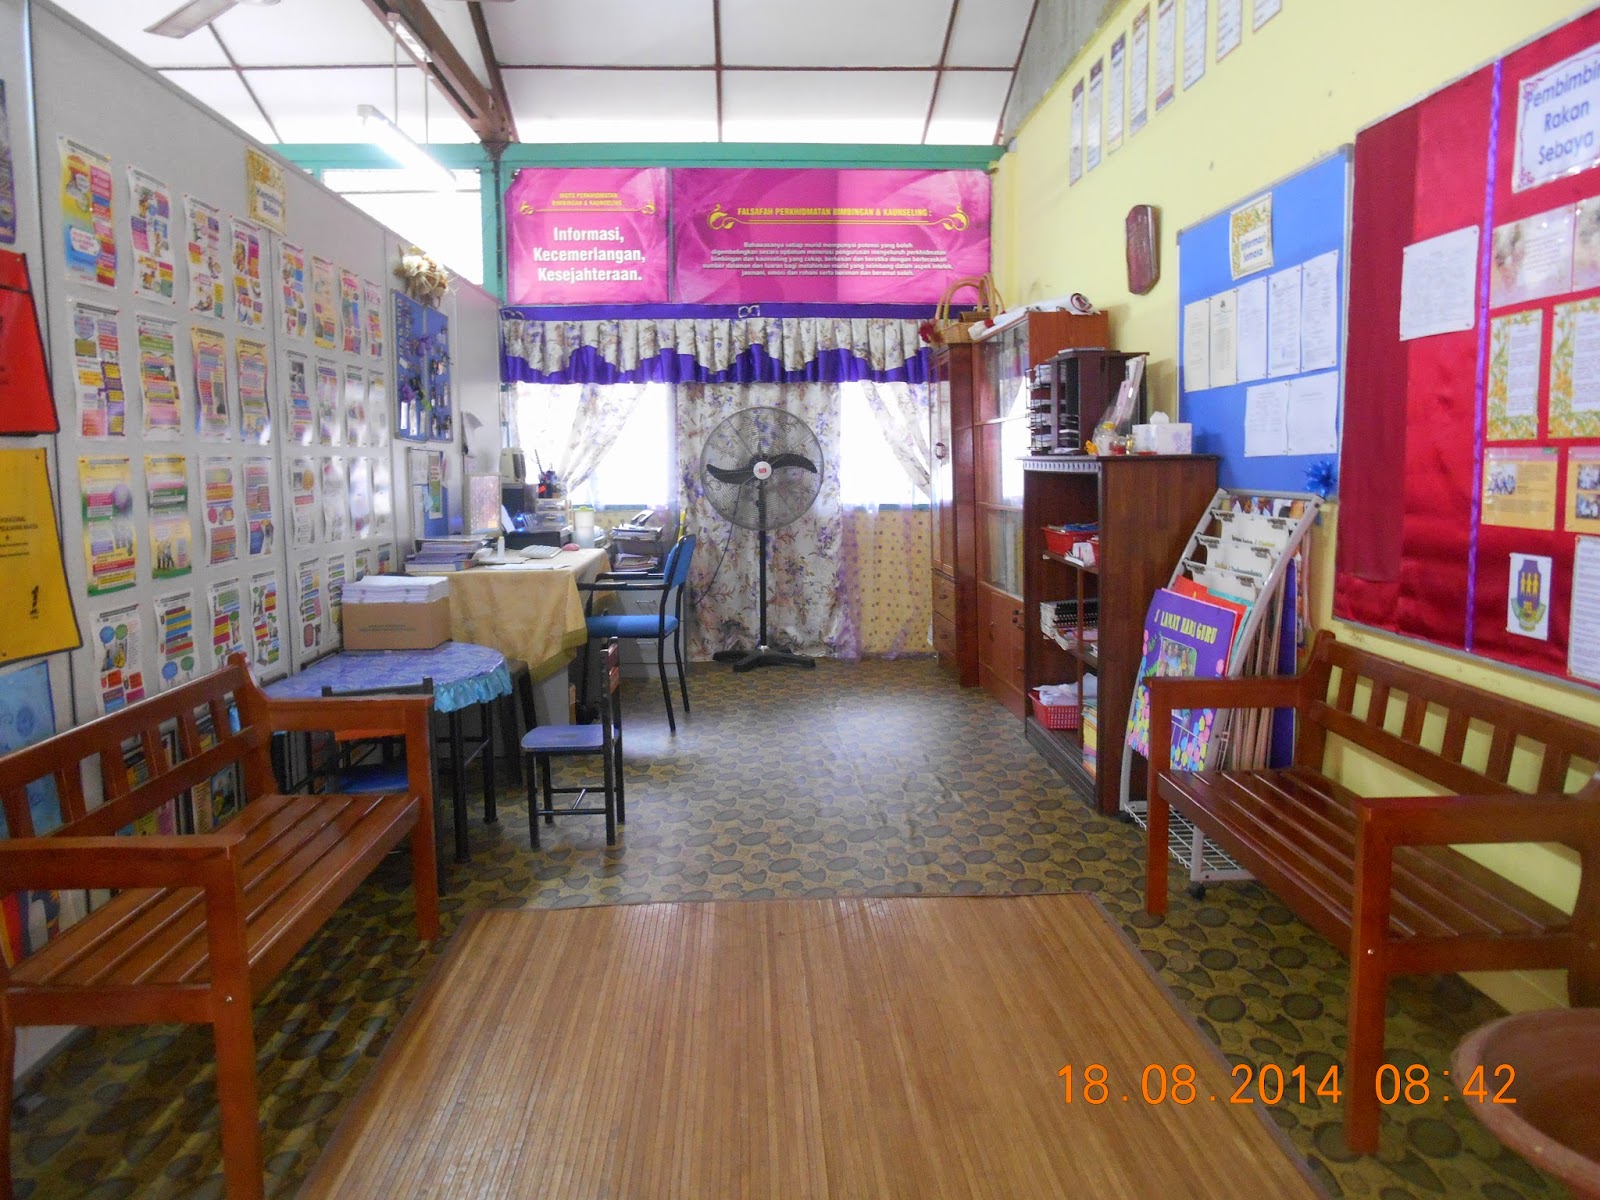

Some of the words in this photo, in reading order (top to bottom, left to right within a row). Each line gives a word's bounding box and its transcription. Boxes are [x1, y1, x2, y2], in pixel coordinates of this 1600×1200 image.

[1544, 100, 1590, 132] Rakan
[1538, 131, 1594, 165] Sebaya
[737, 207, 773, 216] FALSAFAH
[775, 207, 831, 216] PERKHIDMATAN
[833, 207, 874, 216] BIMBINGAN
[875, 207, 881, 216] &
[553, 227, 625, 243] Informasi,
[533, 246, 646, 264] Kecemerlangan,
[537, 267, 643, 284] Kesejahteraan.
[1196, 623, 1218, 645] GURU
